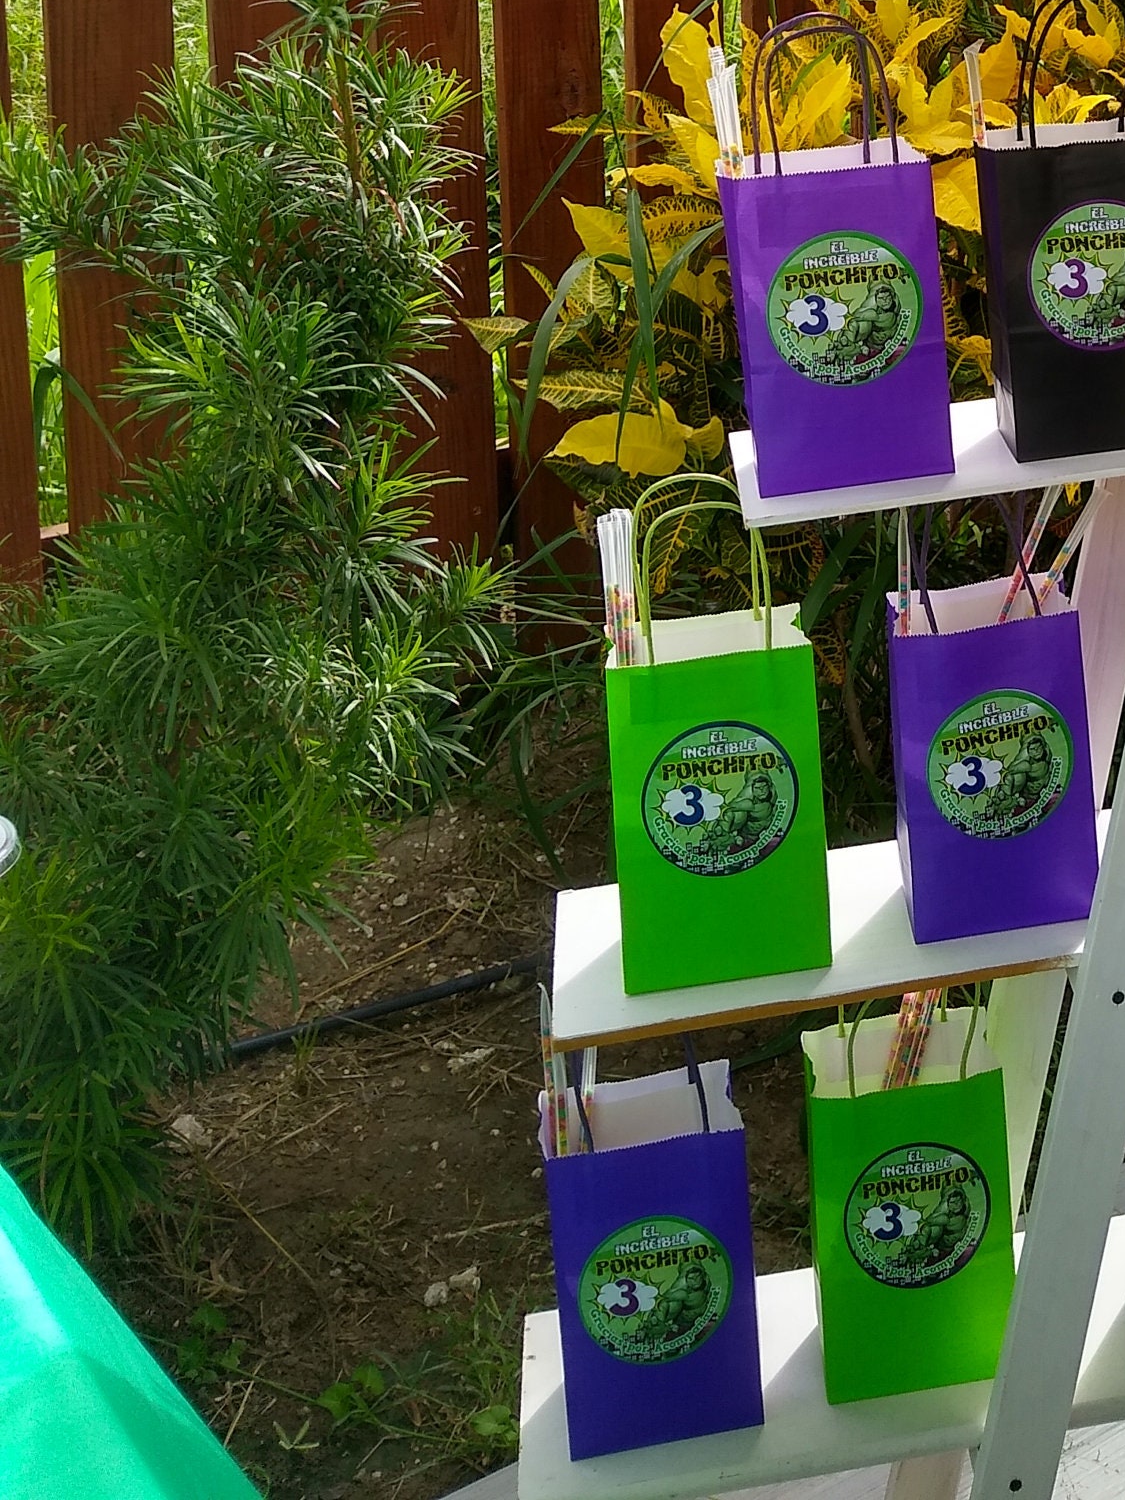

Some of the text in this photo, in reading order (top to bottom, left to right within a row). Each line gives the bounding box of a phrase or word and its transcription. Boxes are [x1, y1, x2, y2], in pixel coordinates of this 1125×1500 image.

[1090, 208, 1108, 218] EL
[804, 250, 878, 270] INCREIBLE
[830, 242, 849, 253] EL
[784, 263, 897, 291] PONCHITO
[1059, 259, 1088, 298] 3
[798, 295, 828, 335] 3
[1040, 289, 1073, 331] Gracias
[1075, 329, 1098, 337] por
[779, 310, 910, 375] Gracias por Acompañarme!
[960, 705, 1028, 735] INCREIBLE
[982, 703, 1000, 715] EL
[682, 739, 757, 760] INCREIBLE
[709, 732, 727, 743] EL
[941, 715, 1050, 756] PONCHITO
[662, 752, 776, 781] PONCHITO
[958, 757, 986, 794] 3
[673, 785, 704, 825] 3
[941, 756, 1061, 831] Gracias por Acompañarme!
[654, 799, 786, 865] Gracias por Acompañarme!
[882, 1156, 951, 1179] INCREIBLE
[907, 1151, 924, 1162] EL
[863, 1167, 969, 1200] PONCHITO
[641, 1227, 660, 1238] EL
[874, 1202, 902, 1240] 3
[596, 1244, 709, 1277] PONCHITO
[615, 1233, 689, 1255] INCREIBLE
[856, 1233, 886, 1272] Gracias
[609, 1279, 639, 1316] 3
[590, 1310, 623, 1348] Gracias
